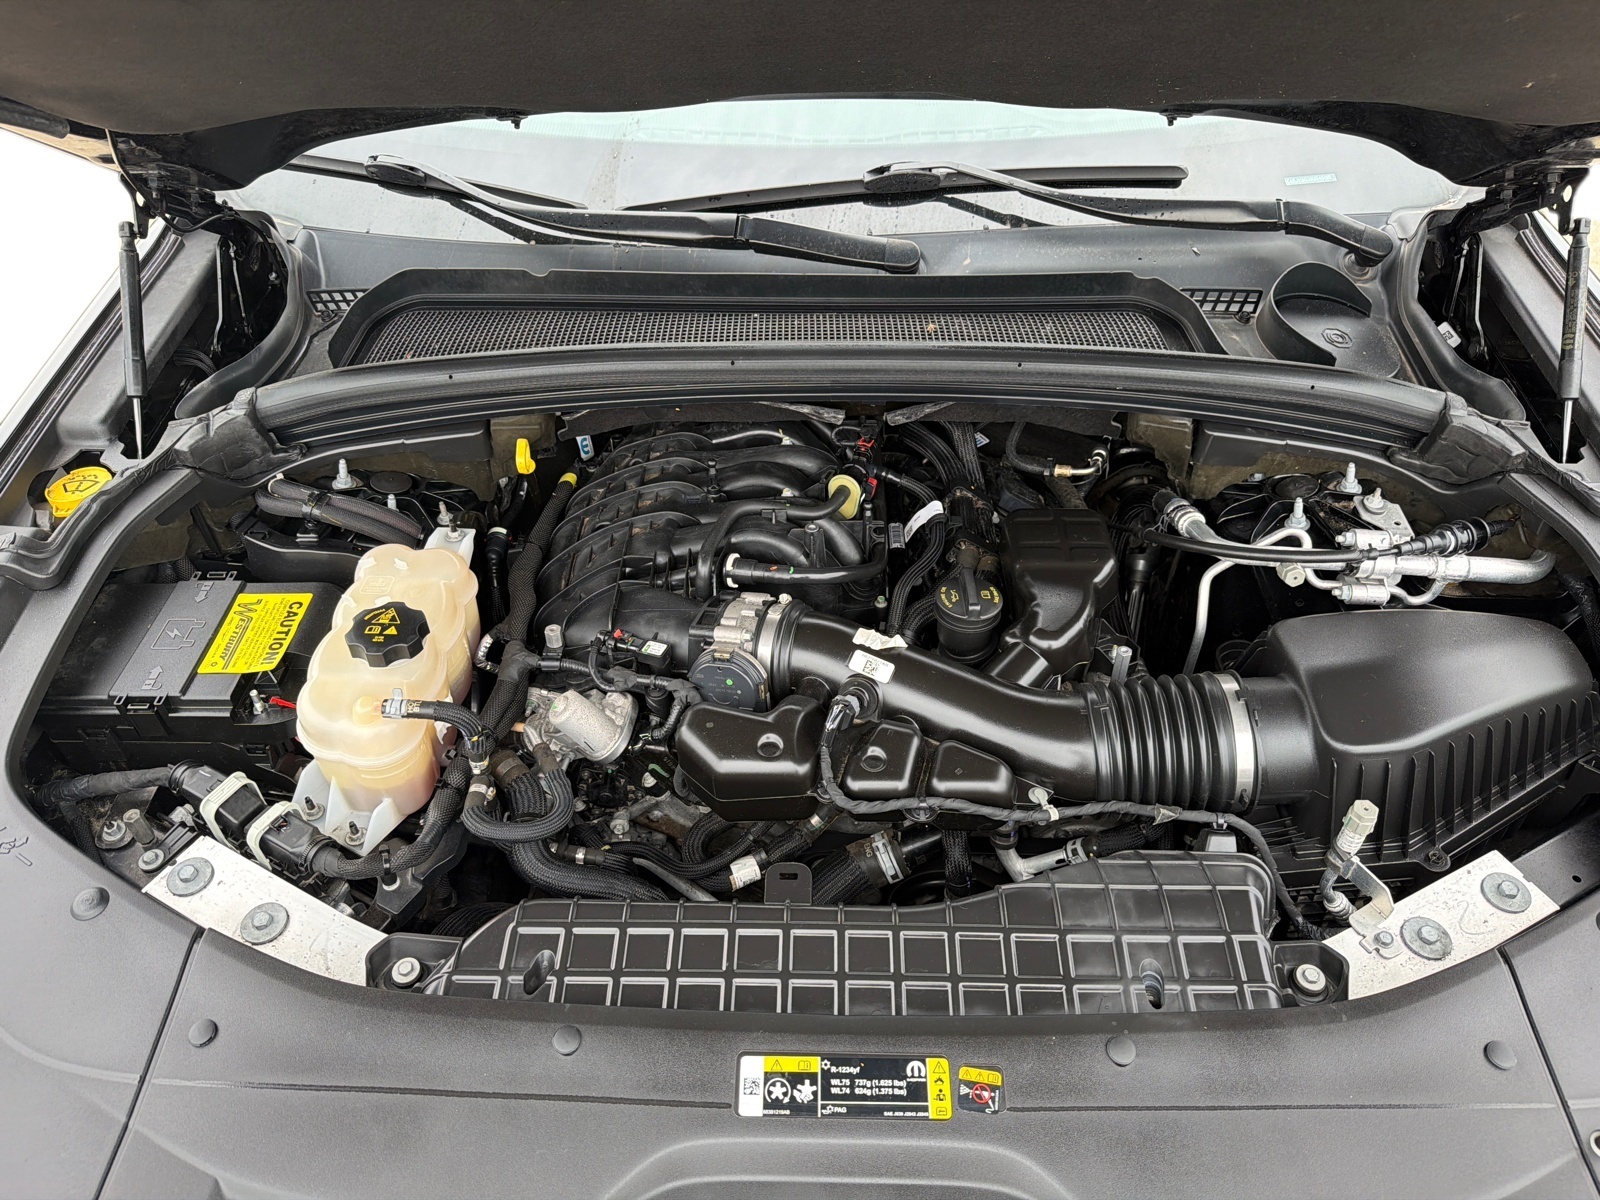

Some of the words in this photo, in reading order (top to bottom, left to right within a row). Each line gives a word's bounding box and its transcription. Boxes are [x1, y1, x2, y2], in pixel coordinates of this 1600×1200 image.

[260, 602, 303, 665] CAUTION!
[864, 842, 874, 858] ENG
[830, 1066, 860, 1074] R-1234yf
